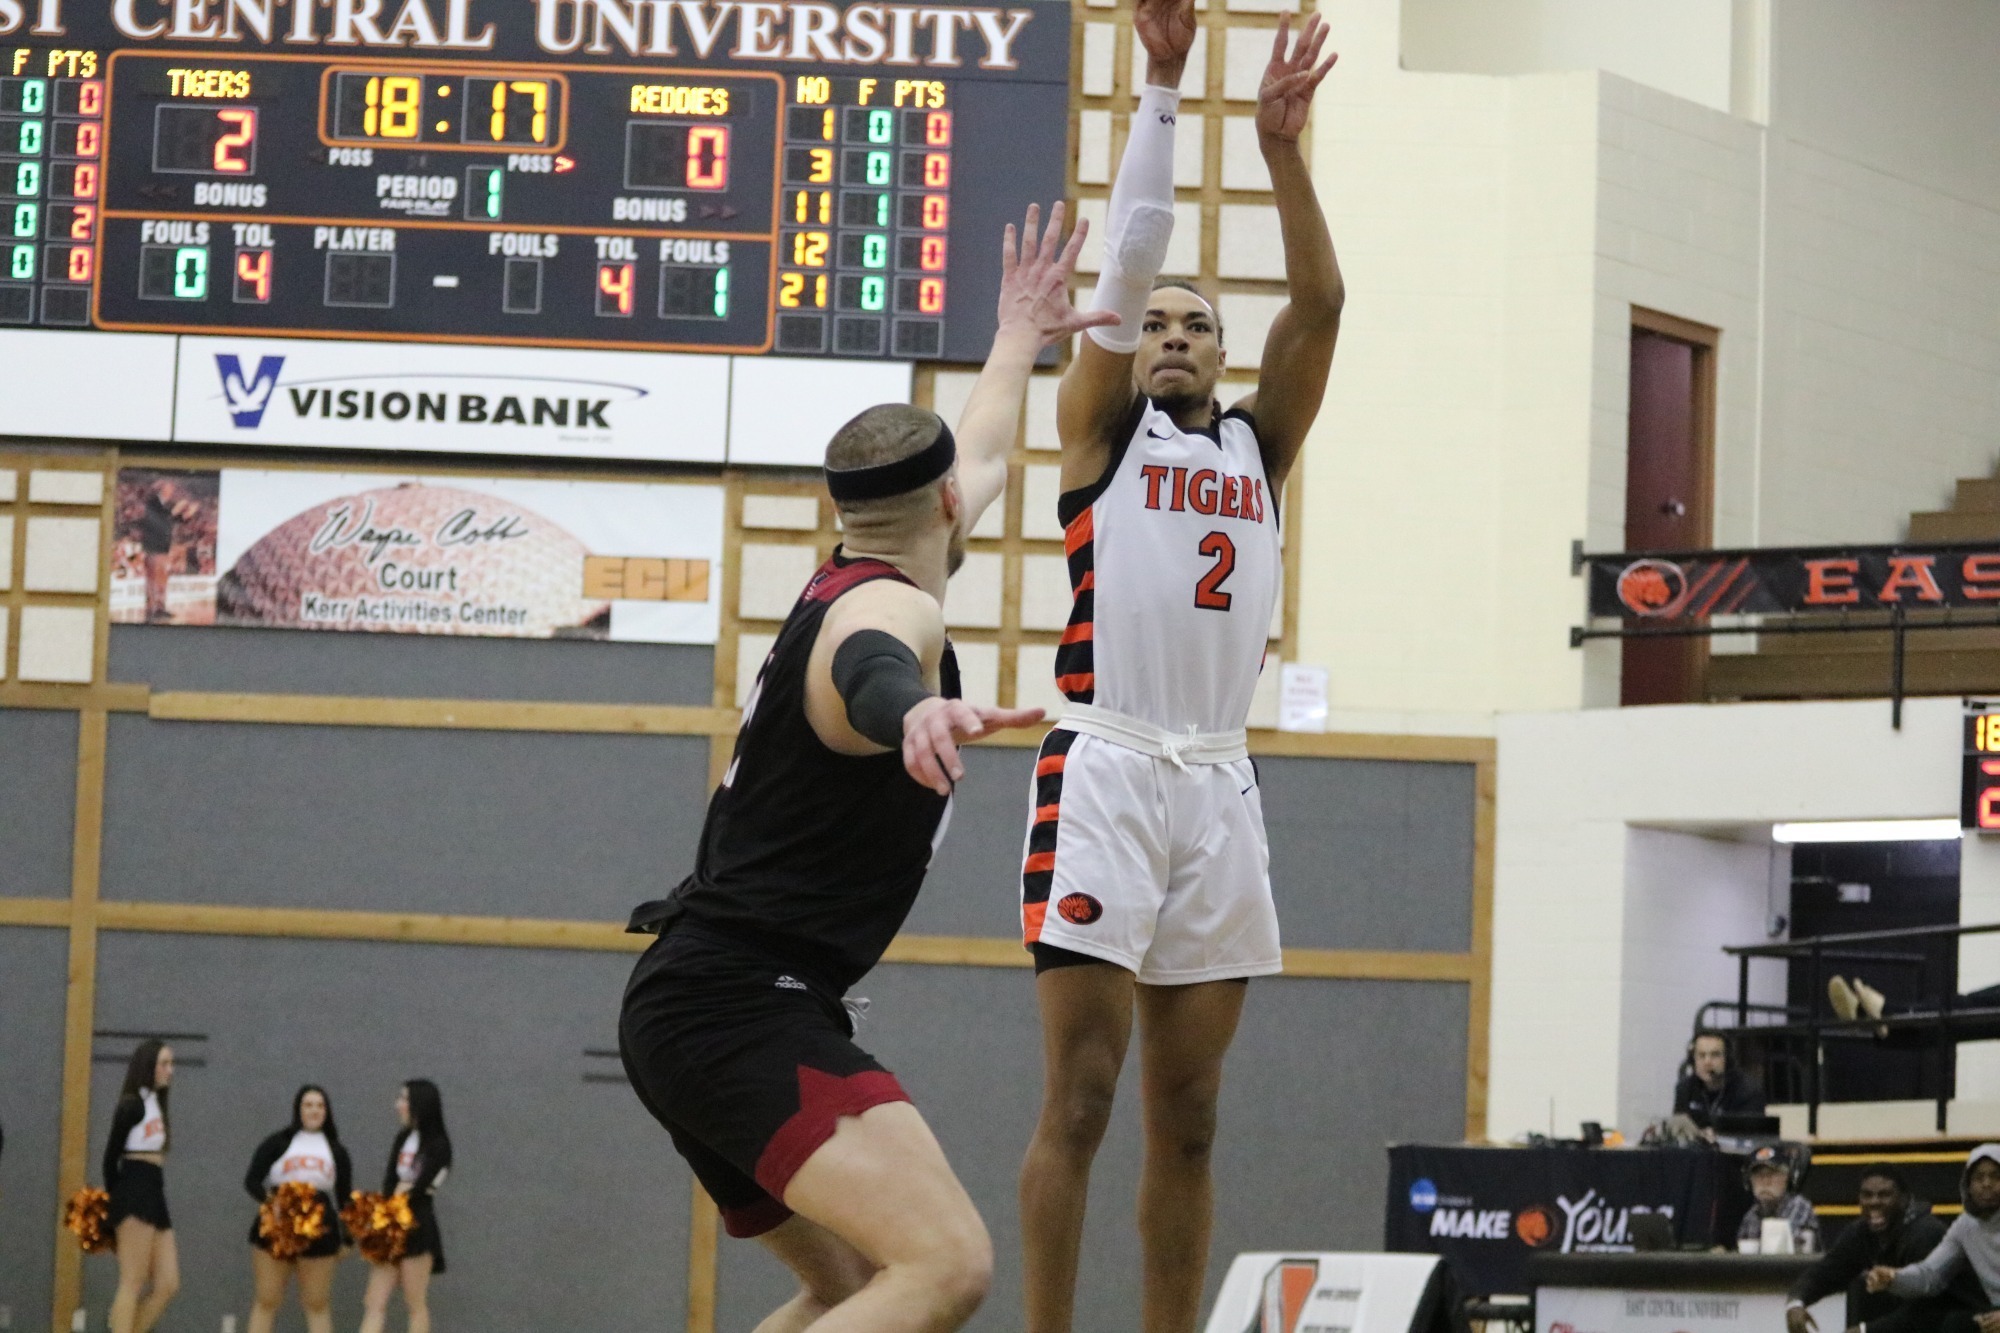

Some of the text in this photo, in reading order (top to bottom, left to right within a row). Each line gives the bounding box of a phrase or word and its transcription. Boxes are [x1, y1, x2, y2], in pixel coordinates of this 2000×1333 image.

[110, 0, 496, 50] CENTRAL
[534, 0, 1033, 69] UNIVERSITY
[13, 48, 98, 78] F PTS
[22, 79, 103, 115] 0 0
[166, 68, 251, 98] TIGERS
[630, 84, 729, 116] REDDIES
[858, 78, 878, 106] F
[894, 79, 945, 108] PTS
[20, 121, 100, 156] 0 0
[214, 109, 256, 172] 2
[822, 108, 951, 146] 1 0 0
[328, 147, 374, 167] POSS
[507, 153, 553, 173] POSS
[686, 126, 729, 189] 0
[808, 148, 949, 187] 3 0 0
[17, 162, 98, 198] 0 0
[194, 181, 268, 208] BONUS
[376, 174, 458, 199] PERIOD
[487, 168, 501, 218] 1
[14, 203, 95, 240] 0 2
[613, 196, 689, 223] BONUS
[796, 190, 947, 229] 11 1 0
[141, 219, 730, 264] FOULS TOL PLAYER FOULS TOL FOULS
[794, 231, 946, 271] 12 0 0
[12, 245, 93, 281] 0 0
[174, 247, 271, 300] 0 4
[600, 263, 729, 317] 4 1
[779, 272, 945, 313] 21 0 0
[1140, 464, 1264, 524] TIGERS
[380, 562, 457, 590] Court
[582, 555, 710, 602] ECU
[1194, 530, 1236, 612] 2
[304, 596, 528, 624] Kerr Activities Center
[1430, 1208, 1512, 1239] MAKE
